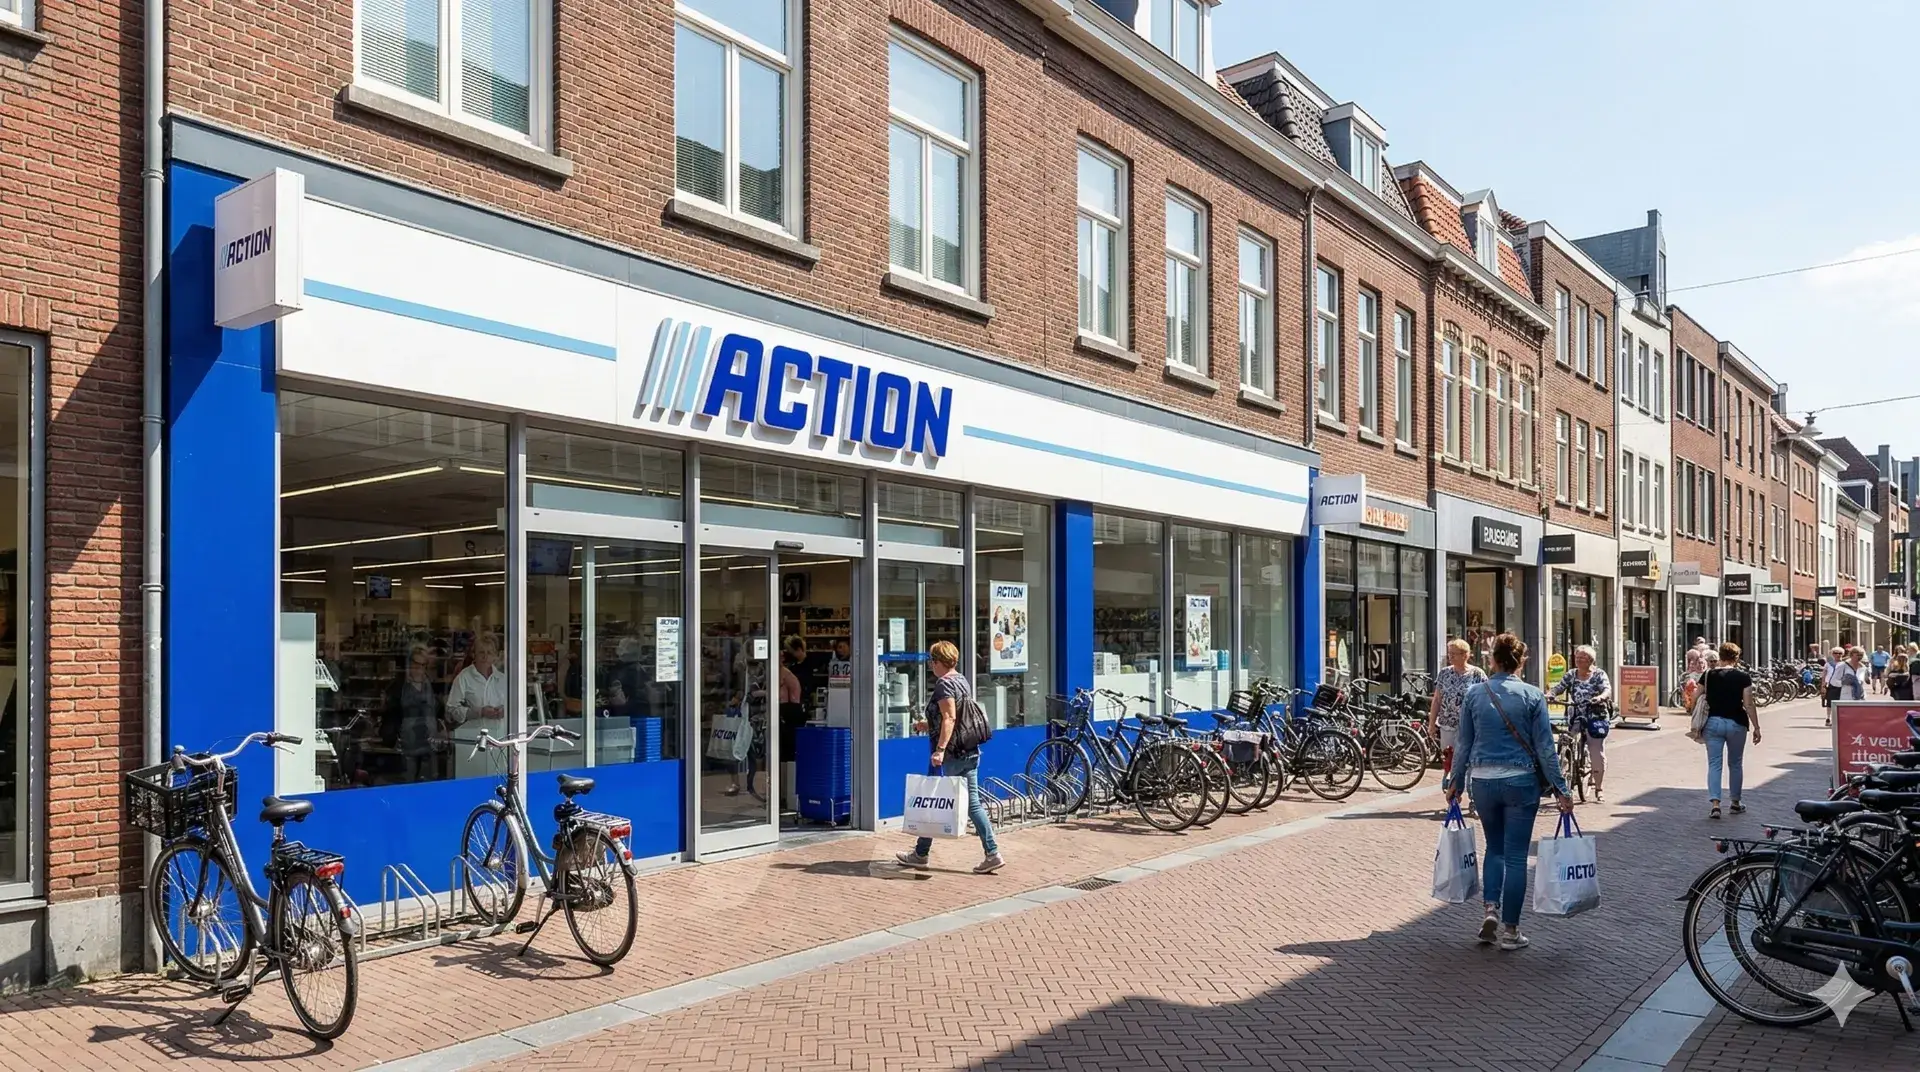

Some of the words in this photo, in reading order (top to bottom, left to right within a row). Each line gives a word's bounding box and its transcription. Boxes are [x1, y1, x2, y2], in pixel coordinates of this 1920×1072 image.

[227, 226, 272, 268] ACTION
[702, 333, 953, 458] ACTION
[1320, 493, 1359, 506] ACTION
[997, 586, 1023, 598] ACTION
[912, 796, 955, 810] ACTION
